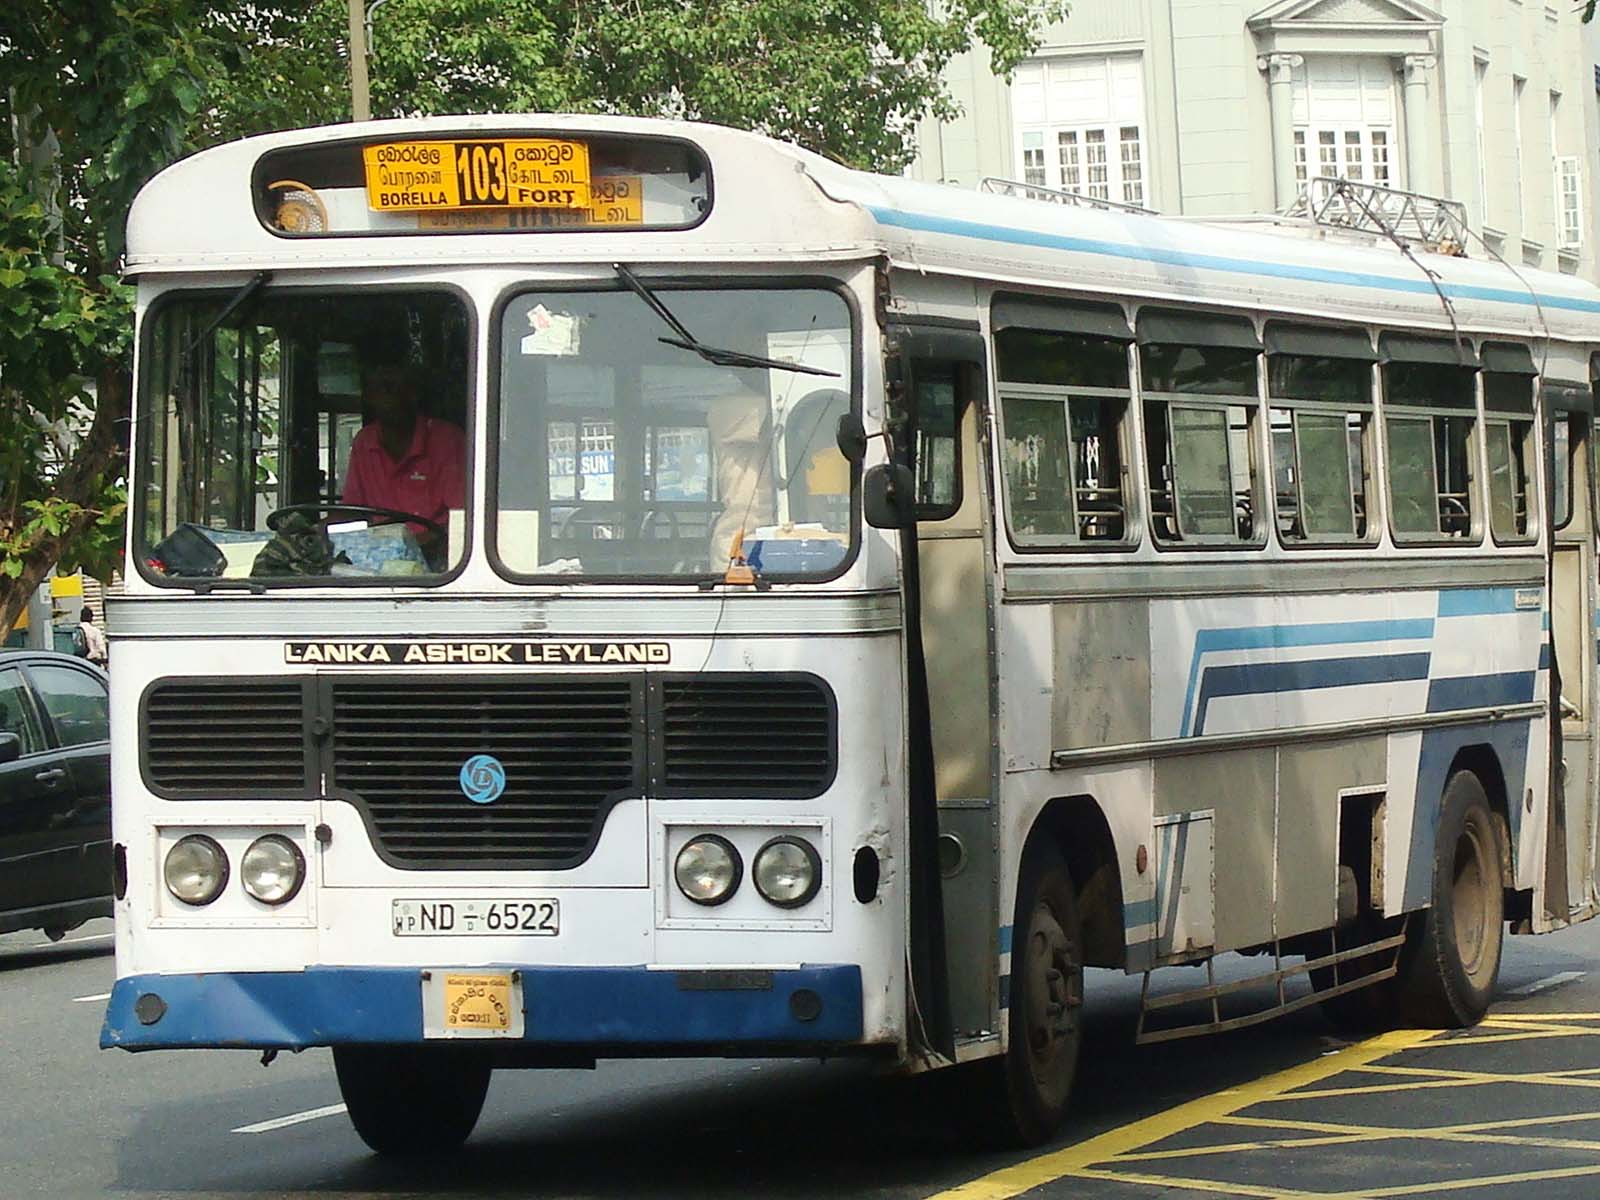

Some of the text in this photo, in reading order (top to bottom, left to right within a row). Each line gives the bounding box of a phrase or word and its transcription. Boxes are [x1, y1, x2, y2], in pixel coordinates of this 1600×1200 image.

[457, 146, 506, 201] 103
[380, 192, 448, 206] BORELLA
[518, 189, 575, 204] FORT
[284, 643, 670, 663] LANKA ASHOK LEYLAND
